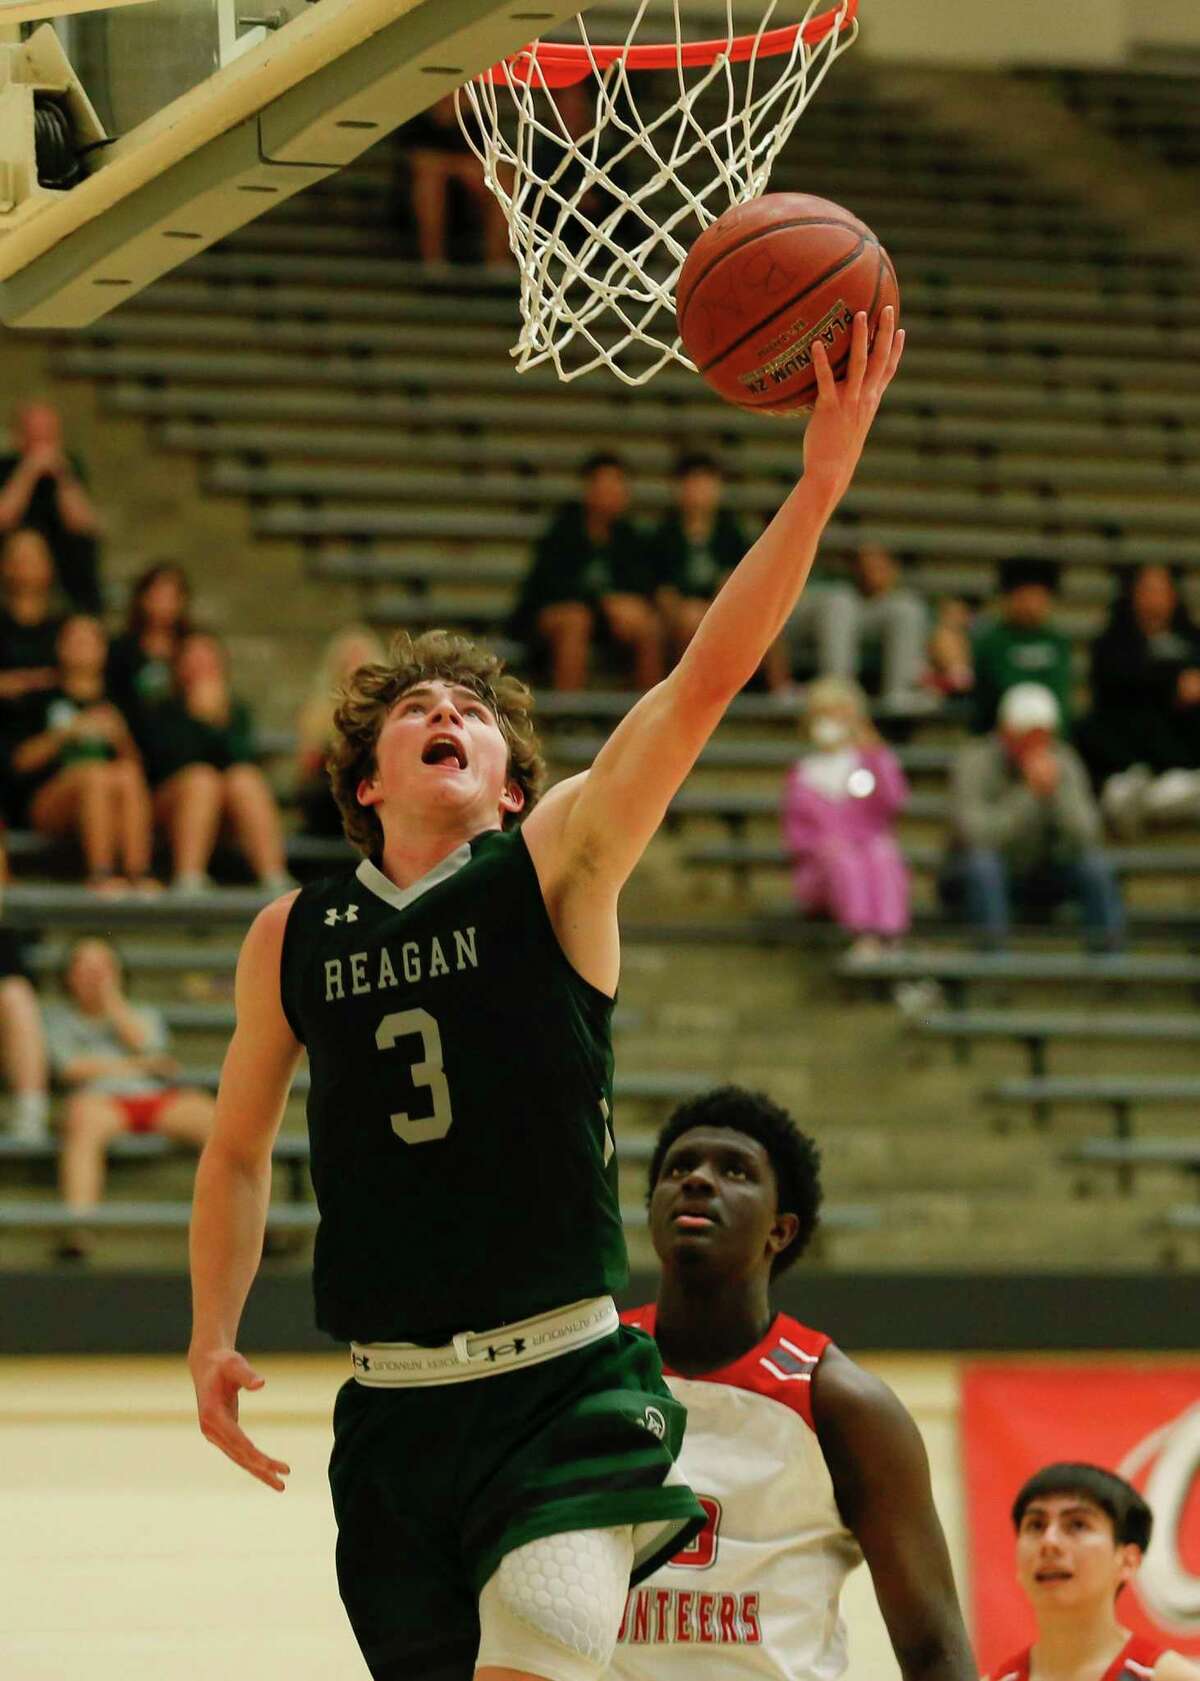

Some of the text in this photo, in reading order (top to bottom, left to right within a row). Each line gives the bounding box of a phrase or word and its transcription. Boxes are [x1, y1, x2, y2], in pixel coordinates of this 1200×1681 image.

[769, 307, 854, 385] PLANUM
[324, 926, 479, 1002] REAGAN
[375, 1007, 453, 1145] 3
